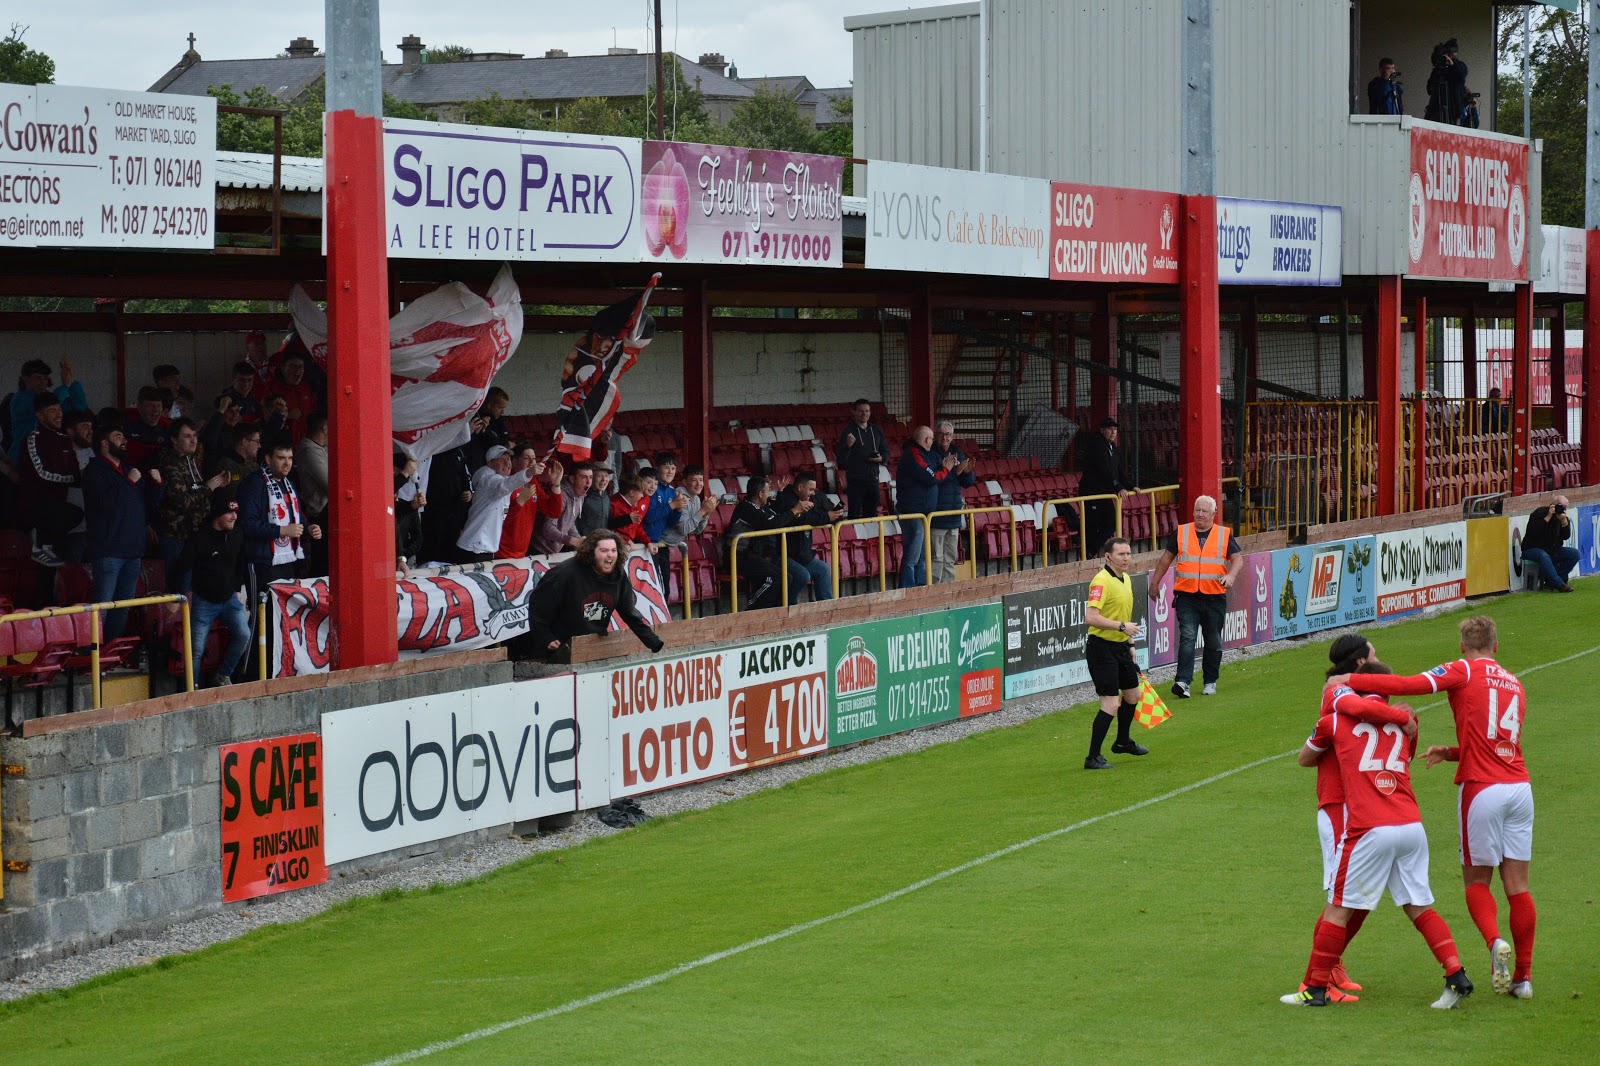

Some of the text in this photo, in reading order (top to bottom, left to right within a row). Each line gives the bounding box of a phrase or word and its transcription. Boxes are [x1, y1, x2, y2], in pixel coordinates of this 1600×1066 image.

[115, 102, 198, 125] OLD MARKET HOUSE,
[115, 126, 197, 147] MARKET YARD, SLIGO
[109, 156, 202, 188] T: 071 9162140
[392, 143, 613, 215] SLIGO PARK
[1425, 148, 1509, 209] SLIGO ROVERS
[697, 154, 841, 233] Feehily's Florist
[1055, 191, 1094, 229] SLIGO
[101, 205, 208, 236] M: 087 2542370
[390, 223, 537, 252] A LEE HOTEL
[872, 189, 1045, 260] LYONS Cafe & Bakeshop
[1270, 214, 1317, 242] INSURANCE
[721, 230, 831, 261] 071-9170000
[1055, 238, 1148, 276] CREDIT UNIONS
[1217, 214, 1251, 274] tings
[1438, 220, 1476, 260] FOOTBALL
[1476, 225, 1496, 260] CLUB
[1152, 255, 1178, 270] Credit Union
[1272, 246, 1313, 273] BROKERS
[1311, 554, 1335, 600] MP
[1381, 531, 1463, 587] The Sligo Champion
[1381, 591, 1414, 614] SUPPORTING
[1416, 587, 1428, 606] THE
[1429, 583, 1461, 603] COMMUNITY
[1024, 603, 1067, 635] TAHENY
[1224, 609, 1248, 642] ROVERS
[1256, 606, 1268, 632] AIB
[739, 639, 815, 679] JACKPOT
[887, 628, 950, 673] WE DELIVER
[1038, 640, 1054, 659] Serving
[1154, 627, 1169, 655] AIB
[611, 654, 722, 719] SLIGO ROVERS
[837, 656, 855, 694] PAPA
[966, 675, 994, 696] ORDER ONLINE
[837, 701, 852, 713] BETTER
[888, 675, 950, 722] 071 9147555
[1486, 687, 1521, 745] 14
[837, 713, 859, 734] BETTER
[358, 701, 582, 833] abbvie
[622, 717, 714, 787] LOTTO
[1352, 722, 1406, 774] 22
[223, 741, 319, 823] S CAFE
[223, 825, 320, 890] 7 FINISKLIN
[265, 855, 310, 887] SLIGO
